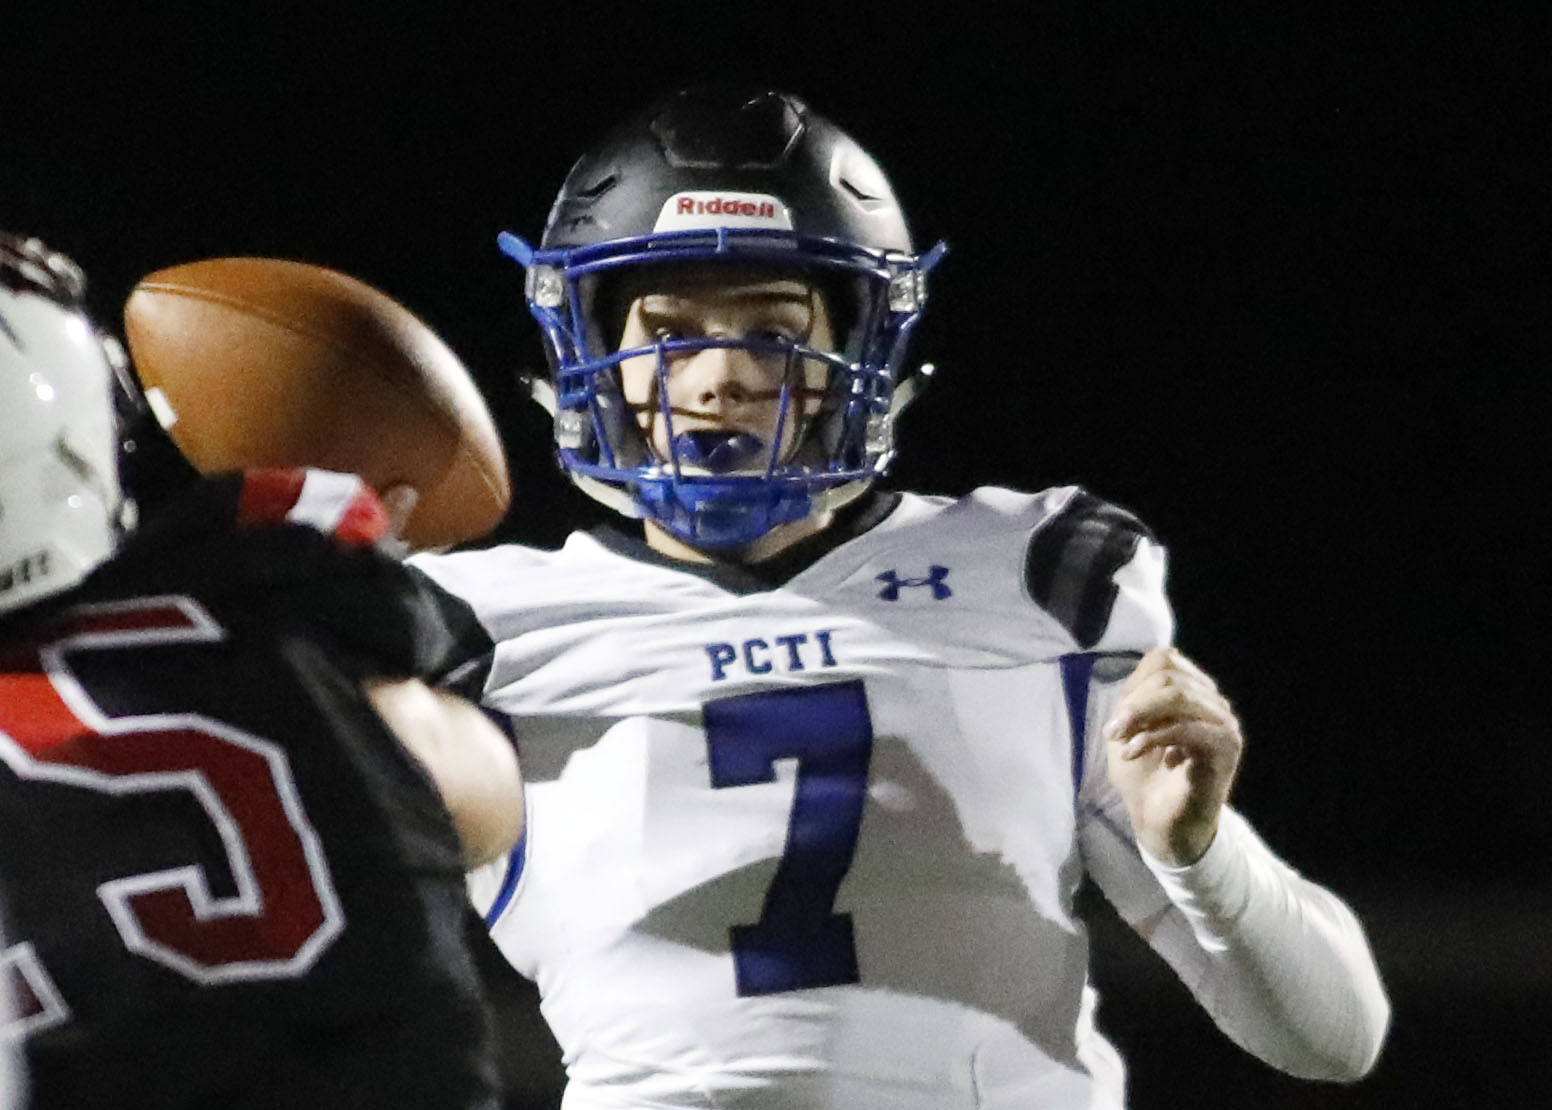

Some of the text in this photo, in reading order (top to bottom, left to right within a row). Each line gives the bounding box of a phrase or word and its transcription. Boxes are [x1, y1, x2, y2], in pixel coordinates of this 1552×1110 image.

[677, 197, 775, 218] Riddell
[704, 629, 838, 681] PCTI
[701, 679, 872, 997] 7
